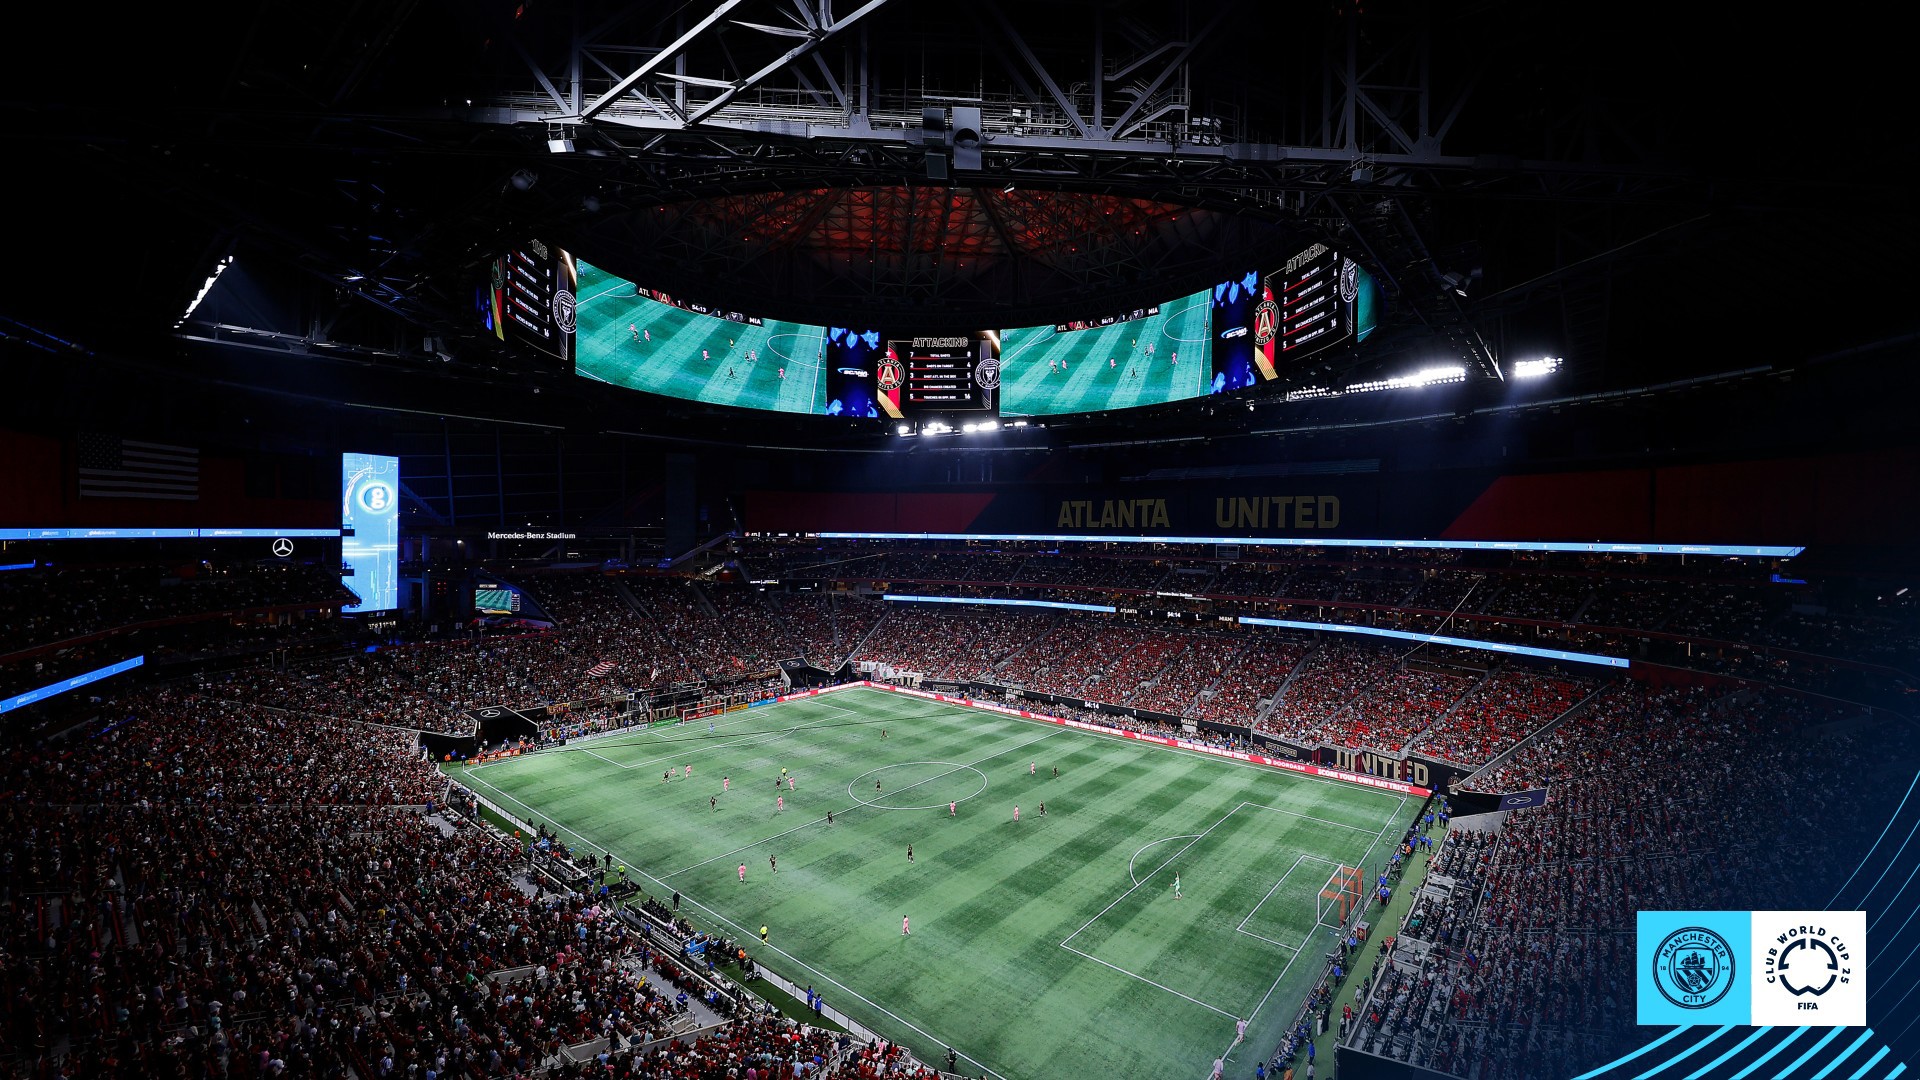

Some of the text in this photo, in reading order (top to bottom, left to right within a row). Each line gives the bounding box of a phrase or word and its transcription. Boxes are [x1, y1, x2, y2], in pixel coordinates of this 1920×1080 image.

[639, 287, 650, 297] ATL
[749, 317, 761, 325] MIA
[1148, 307, 1159, 315] MIA
[912, 337, 968, 348] ATTACKING
[1057, 496, 1340, 529] ATLANTA UNITED
[487, 531, 545, 539] Mercedes-Benz
[1006, 688, 1025, 696] ATLANTA
[1180, 718, 1198, 726] MIAMI
[1273, 760, 1306, 772] DOORDASH
[1318, 769, 1339, 779] SCORE
[1339, 773, 1357, 782] YOUR
[1357, 776, 1375, 786] OWN
[1375, 780, 1389, 788] HAT
